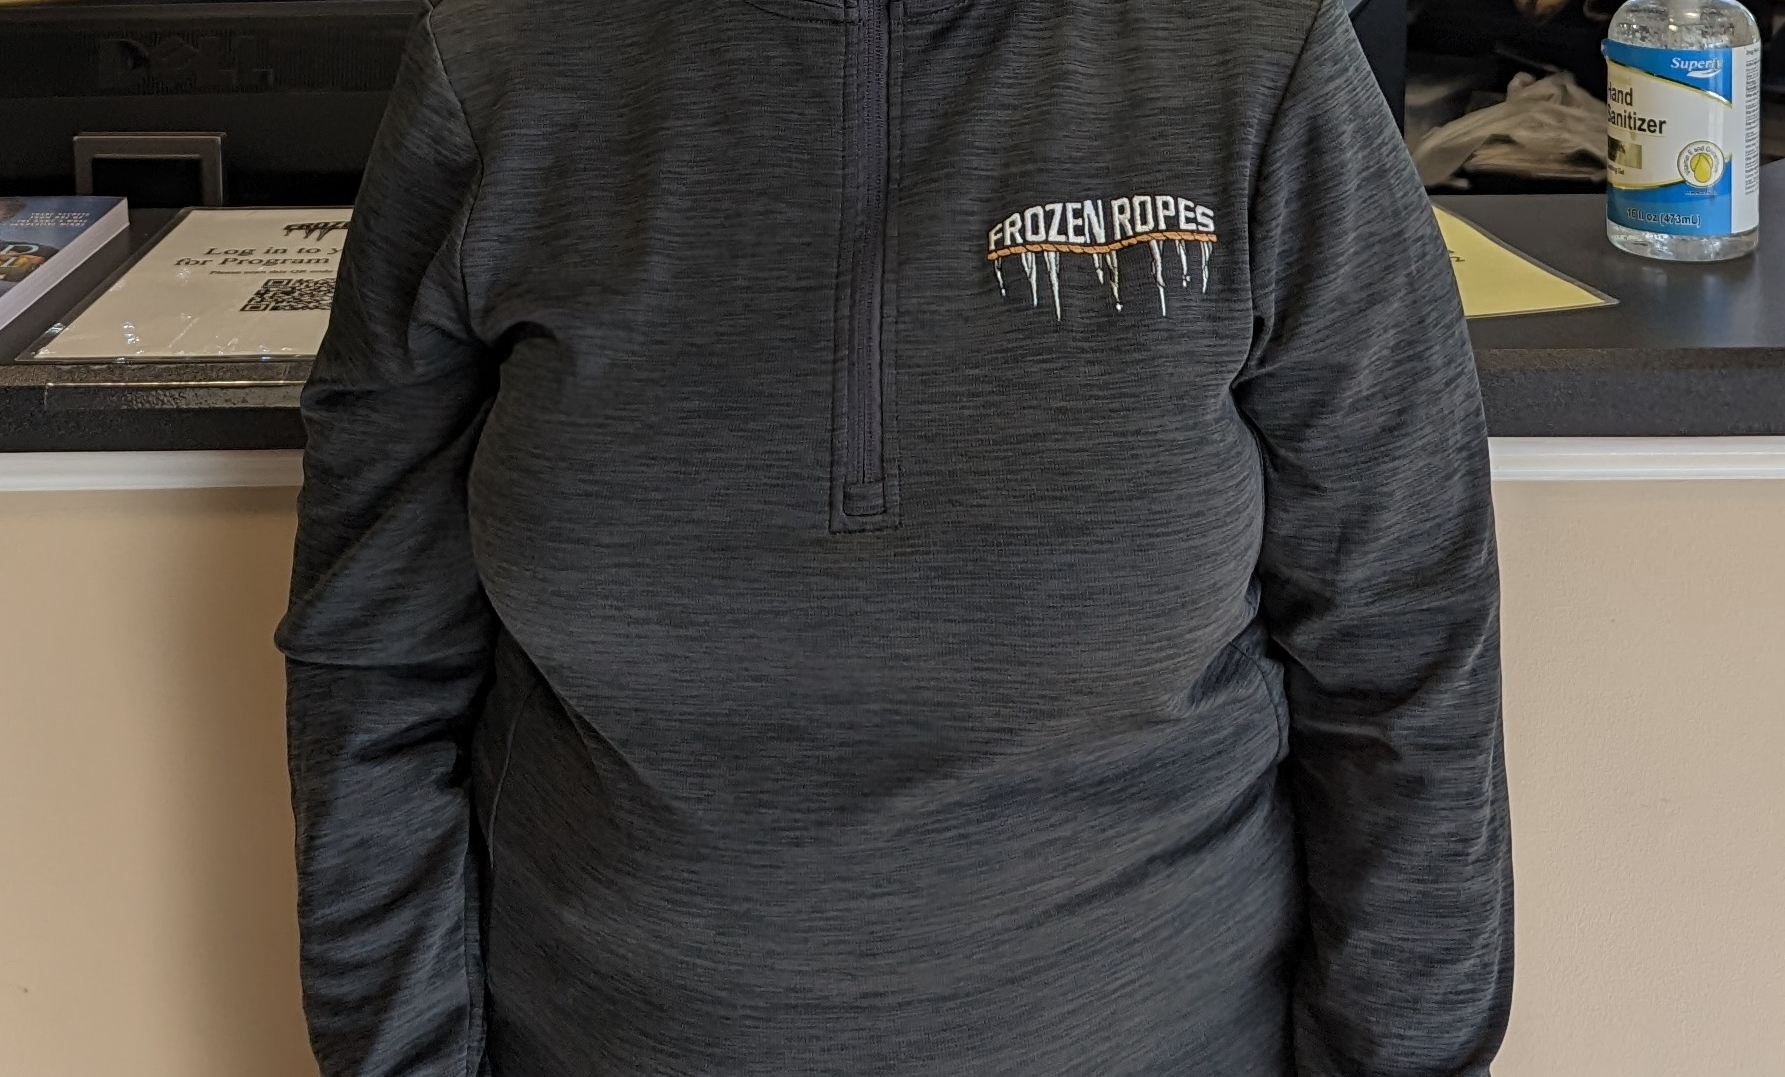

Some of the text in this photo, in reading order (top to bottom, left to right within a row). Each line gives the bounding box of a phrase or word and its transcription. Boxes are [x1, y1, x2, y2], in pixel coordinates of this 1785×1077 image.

[98, 35, 274, 90] DELL
[988, 195, 1216, 251] FROZEN ROPES
[1626, 207, 1637, 219] 16
[1646, 212, 1658, 223] oz
[204, 247, 256, 257] Log
[263, 247, 288, 255] in
[173, 257, 330, 267] for Program
